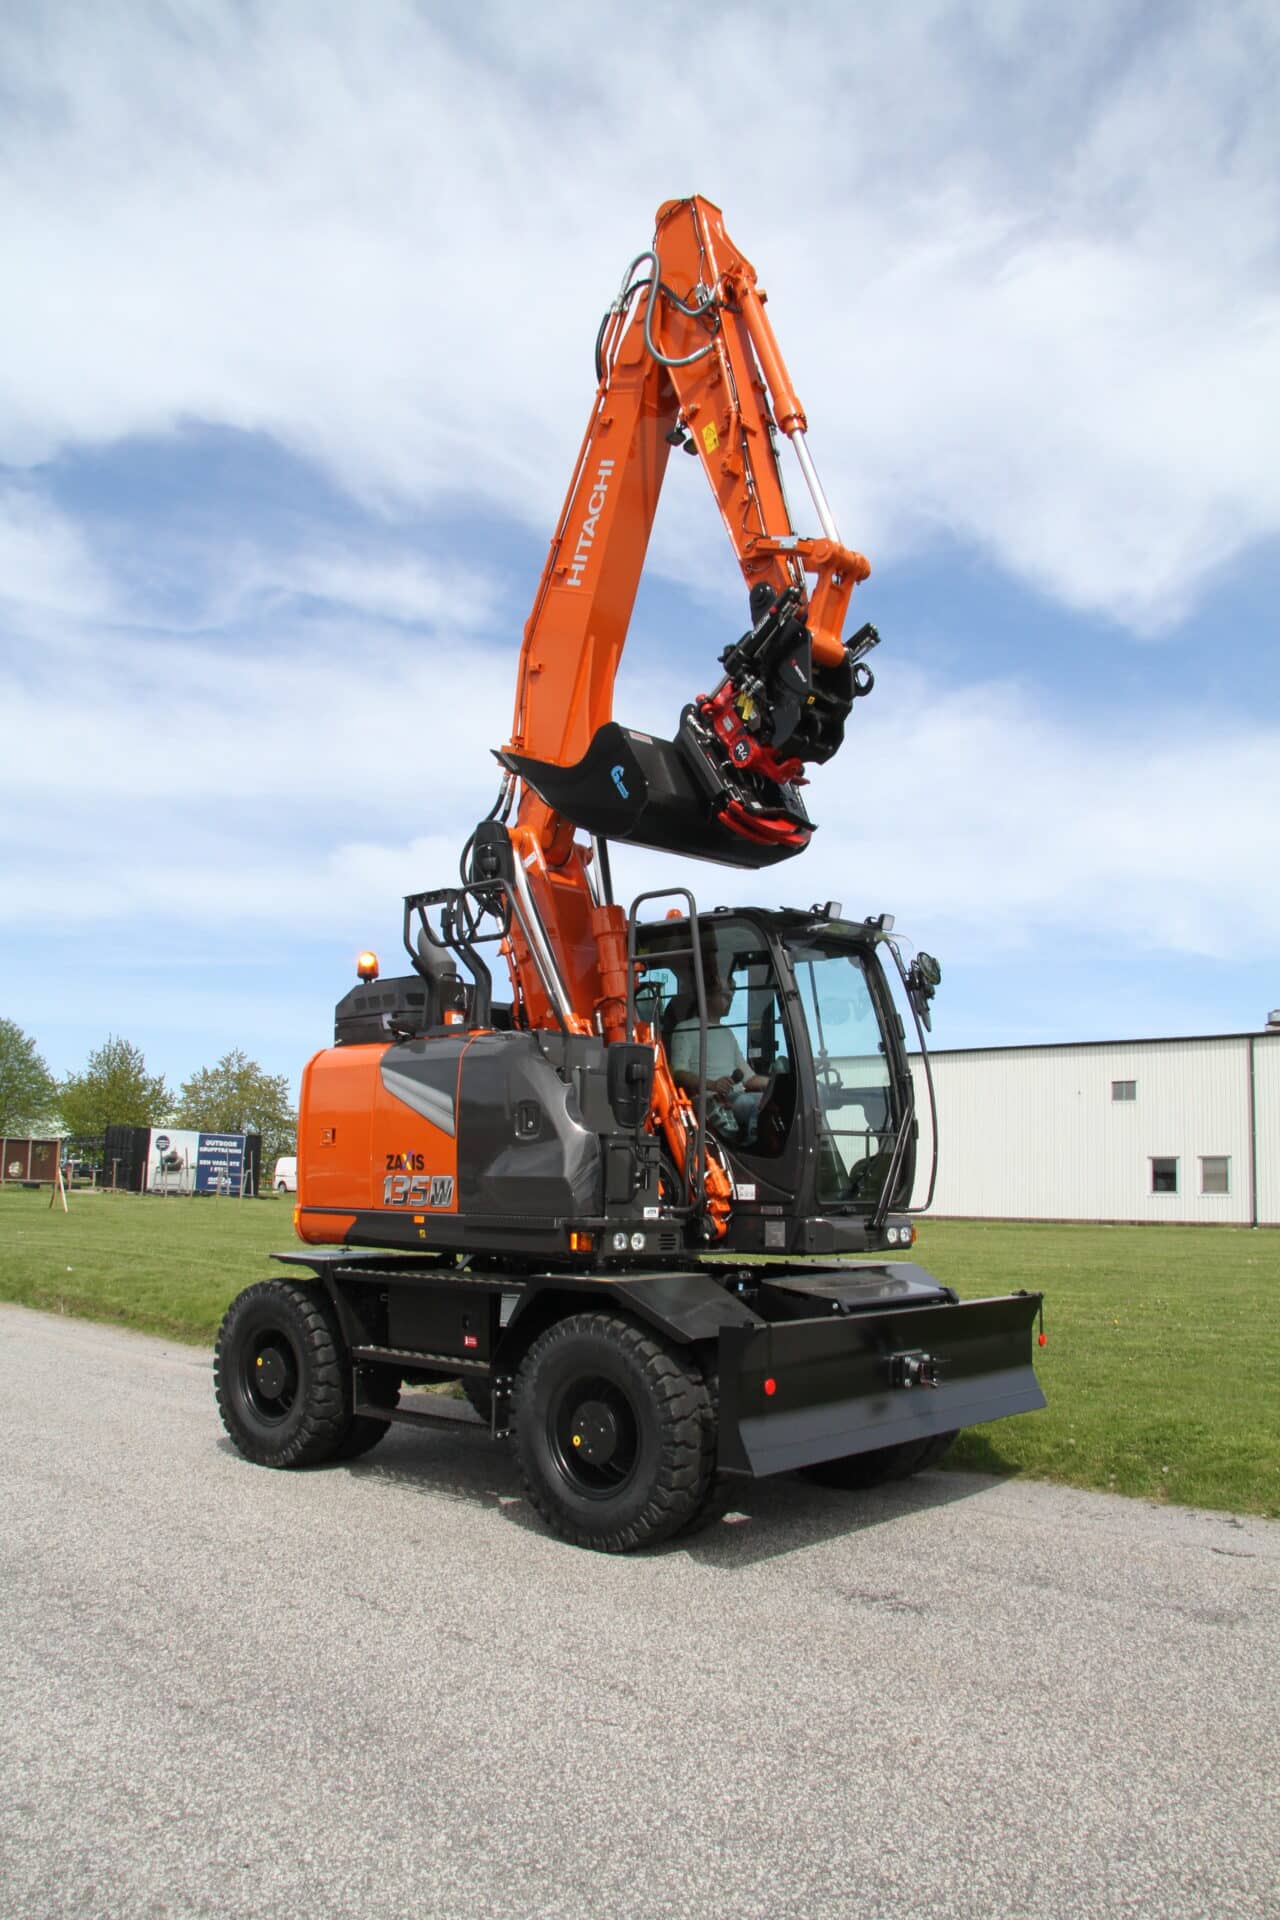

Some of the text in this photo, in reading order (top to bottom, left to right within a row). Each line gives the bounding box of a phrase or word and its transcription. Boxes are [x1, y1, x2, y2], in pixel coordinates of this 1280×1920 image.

[567, 460, 615, 586] HITACHI
[385, 1150, 425, 1171] ZAXIS
[383, 1174, 455, 1208] 135W
